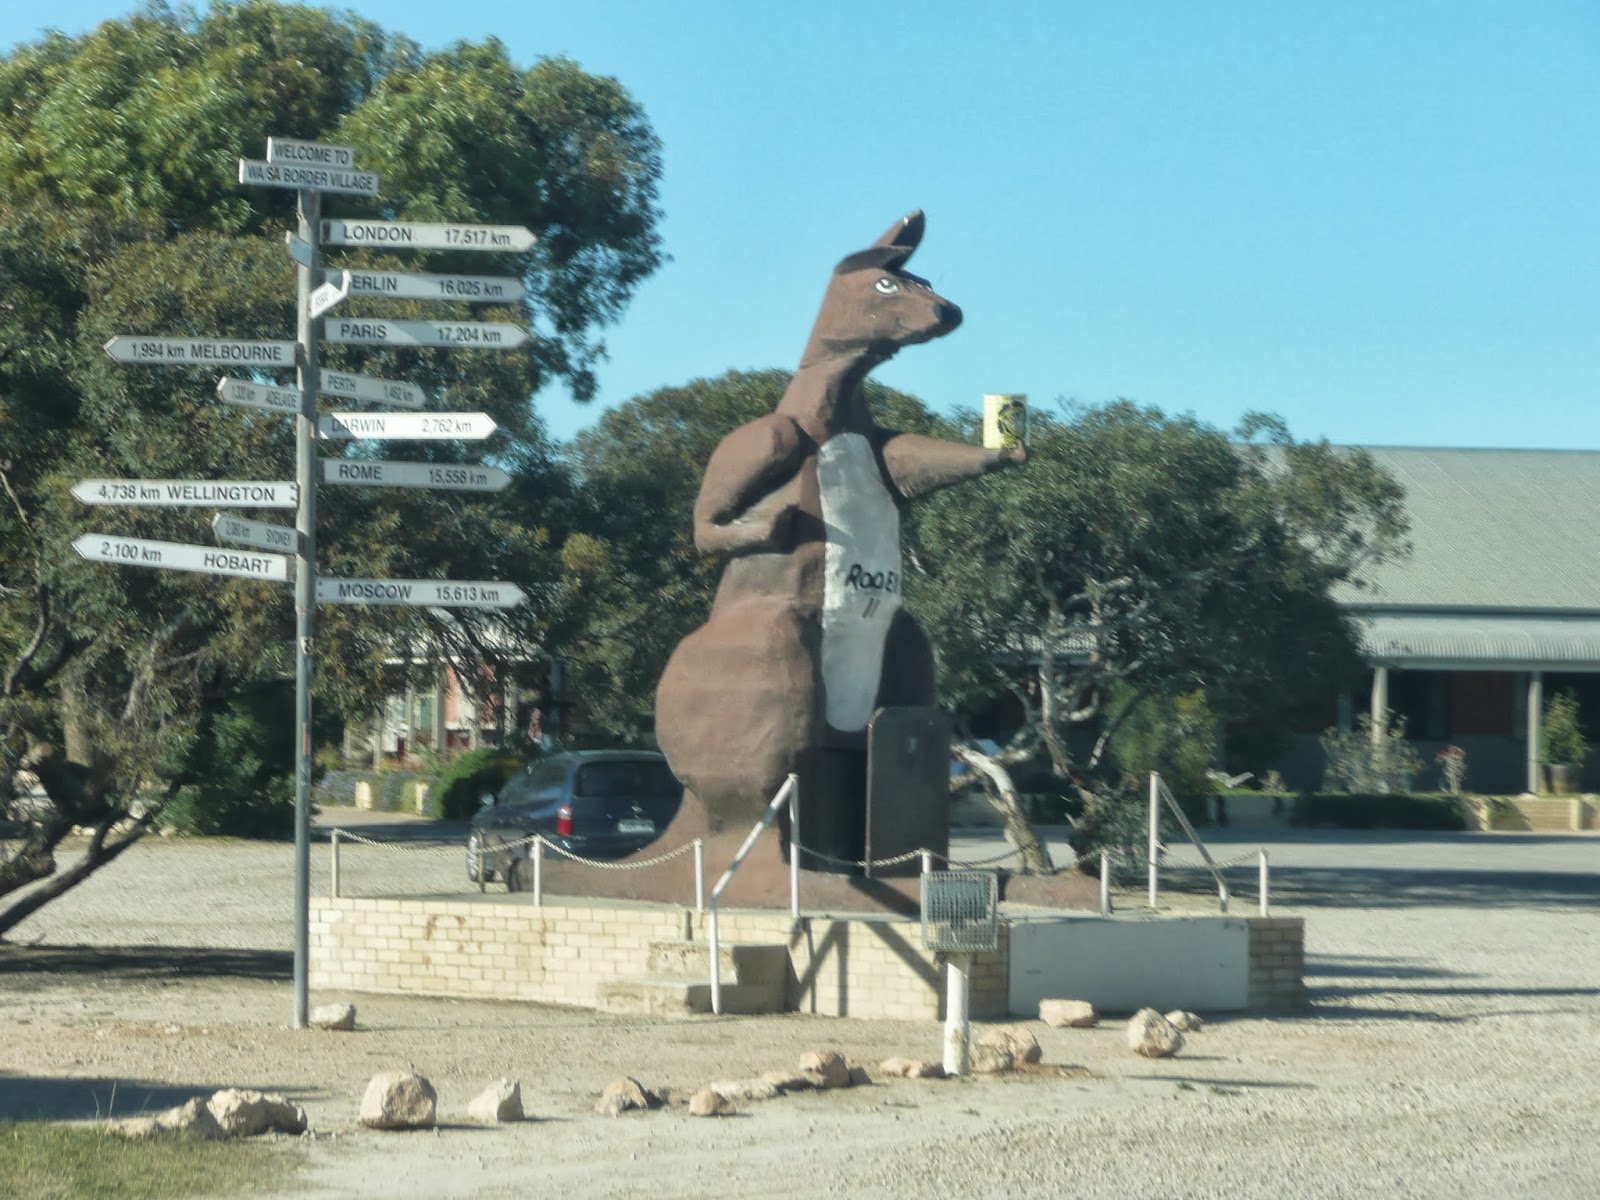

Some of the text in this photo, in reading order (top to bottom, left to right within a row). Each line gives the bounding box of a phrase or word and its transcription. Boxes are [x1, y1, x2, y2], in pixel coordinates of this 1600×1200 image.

[273, 143, 349, 165] WELCOME TO
[246, 163, 374, 191] WA SA BORDER VILLAGE
[344, 225, 511, 246] LONDON 17,517 km
[351, 274, 503, 297] ERLIN 16,025 km
[340, 323, 501, 343] PARIS 17,204 km
[167, 344, 185, 358] km
[190, 343, 282, 361] MELBOURNE
[327, 374, 357, 393] PERTH
[266, 389, 297, 409] ADELAIDE
[332, 418, 472, 434] DARWIN 2,762 km
[339, 463, 488, 486] ROME 15,558 km
[99, 484, 275, 502] 4,738 km WELLINGTON
[101, 541, 272, 574] 2,100 km HOBART
[338, 583, 500, 602] MOSCOW 15,613 km
